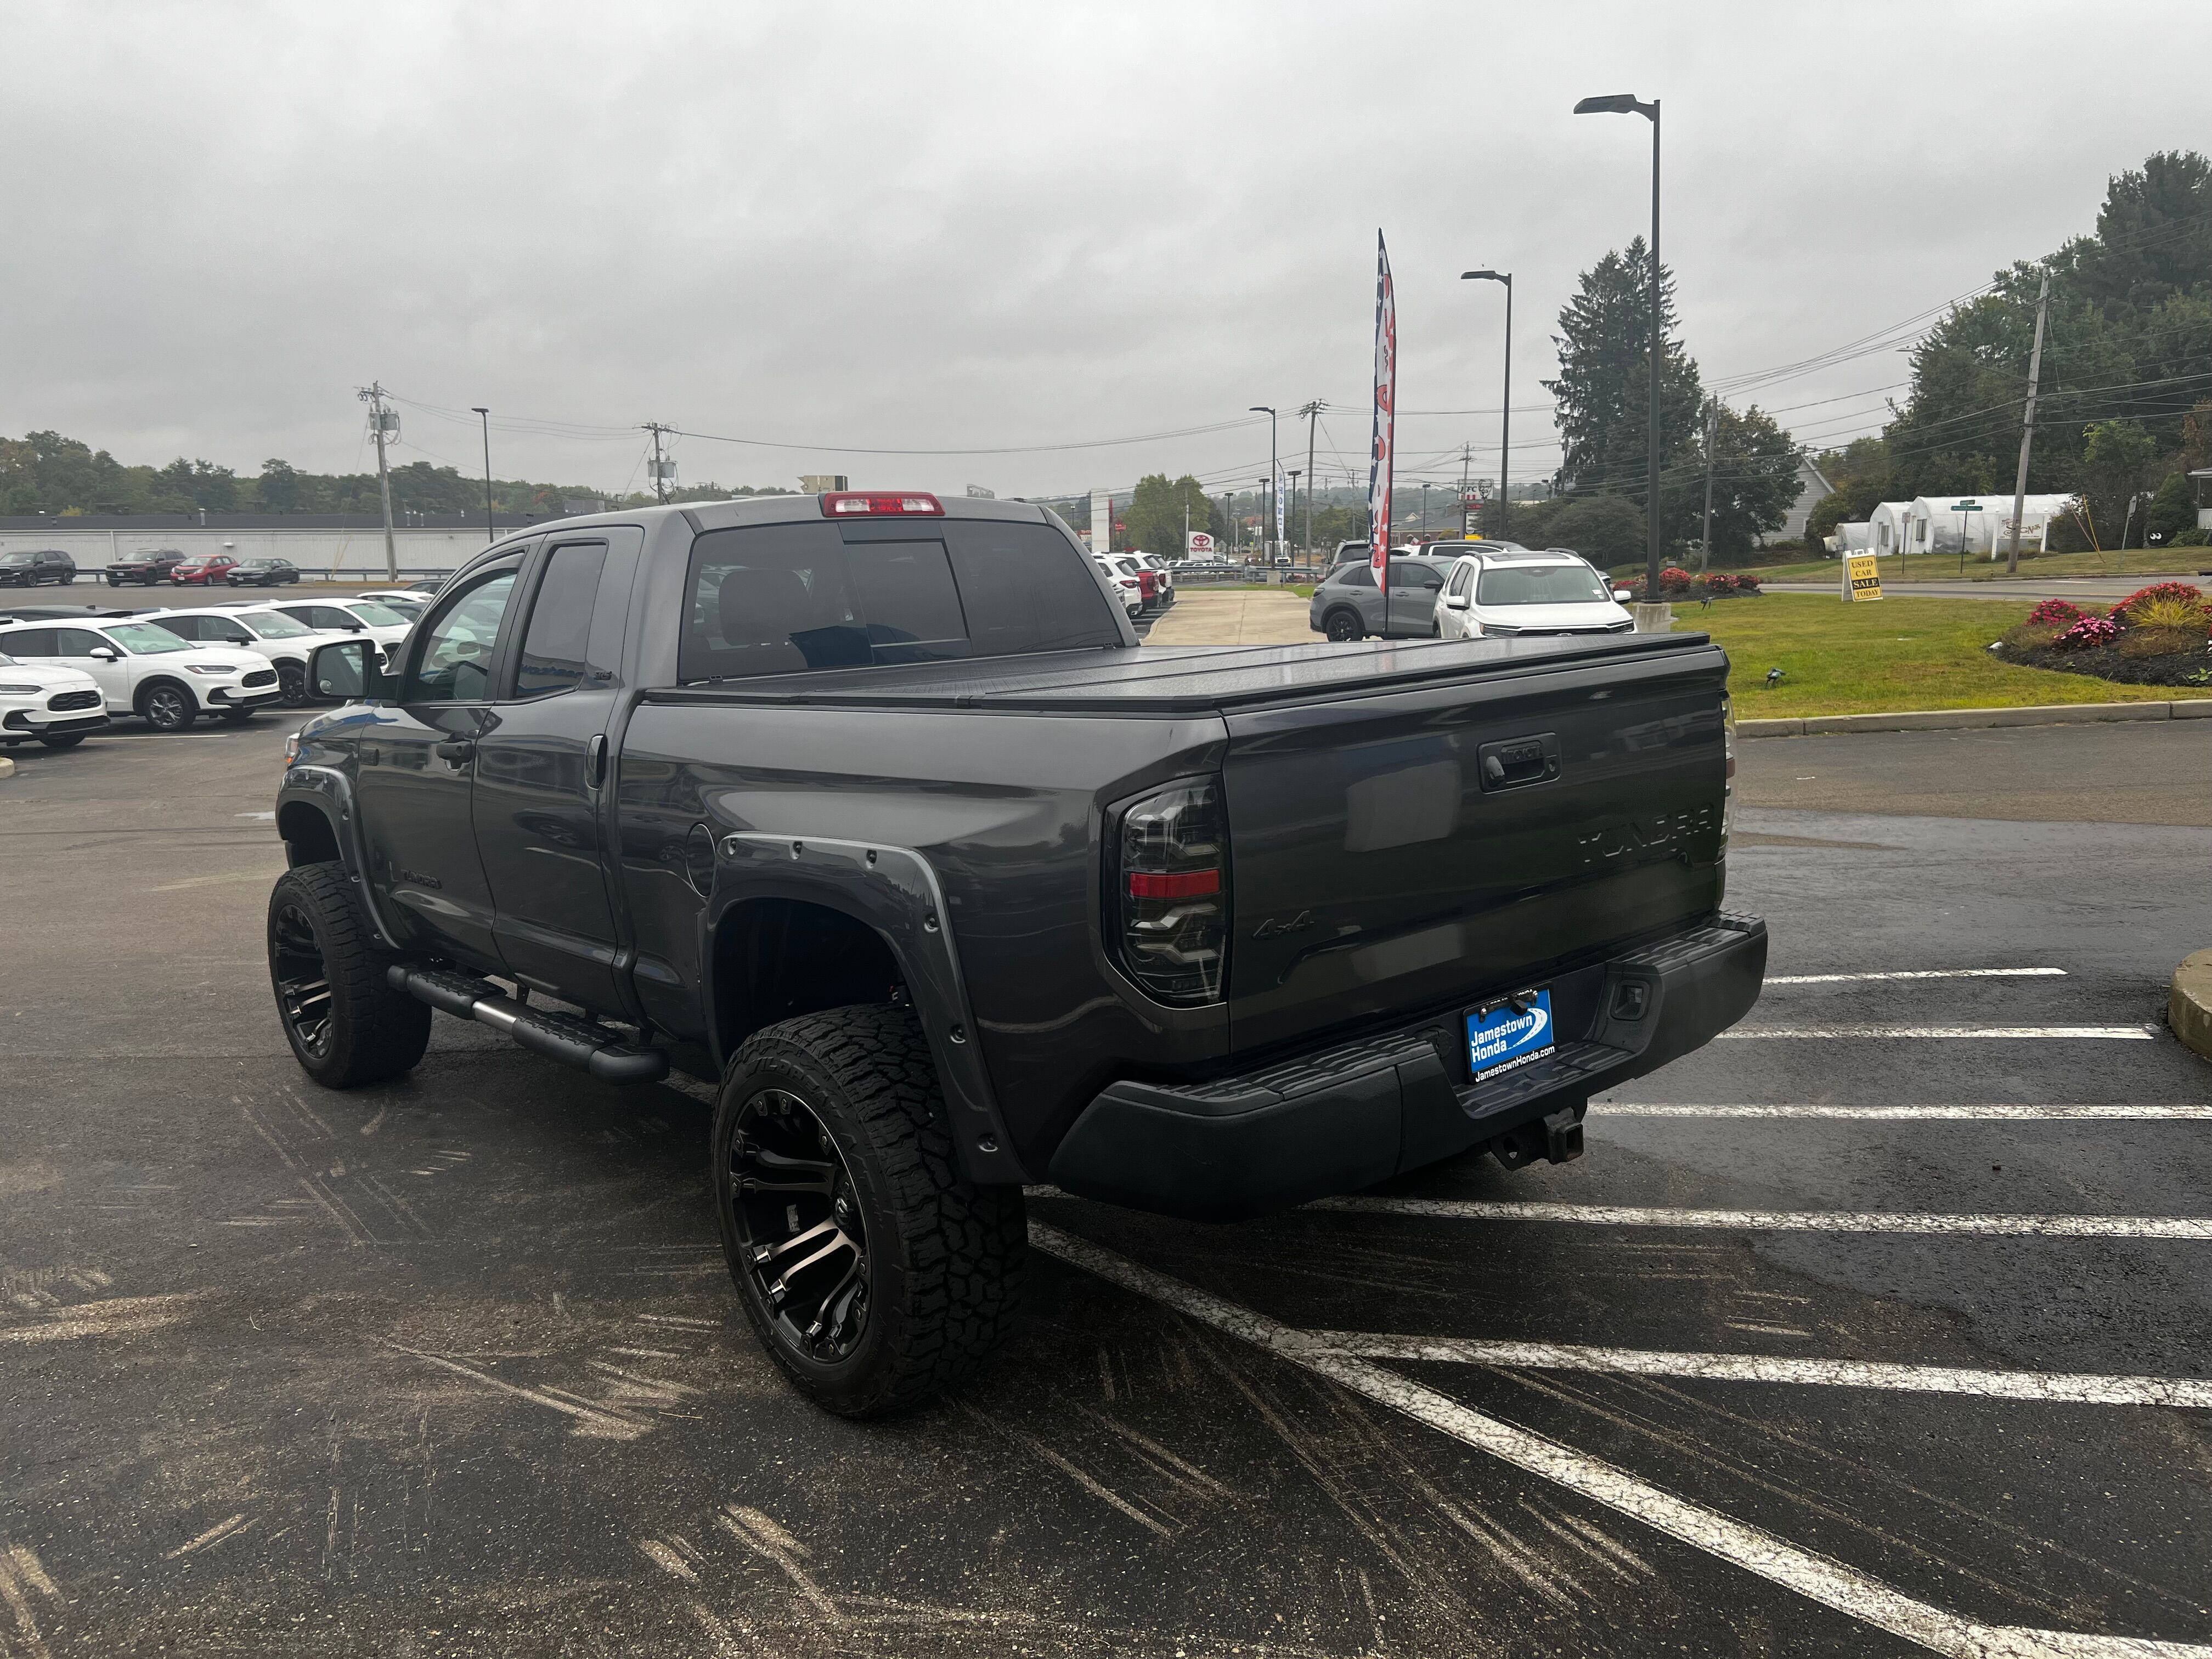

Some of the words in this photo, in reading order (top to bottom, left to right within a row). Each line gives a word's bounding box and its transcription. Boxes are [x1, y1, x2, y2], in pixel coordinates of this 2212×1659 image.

[1852, 560, 1873, 568] USED
[1855, 569, 1872, 577] CAR
[1853, 578, 1878, 588] SALE
[1856, 589, 1879, 597] TODAY
[1471, 1015, 1533, 1047] Jamestown
[1472, 1038, 1508, 1063] Honda
[1476, 1046, 1555, 1082] JamestownHonda.com
